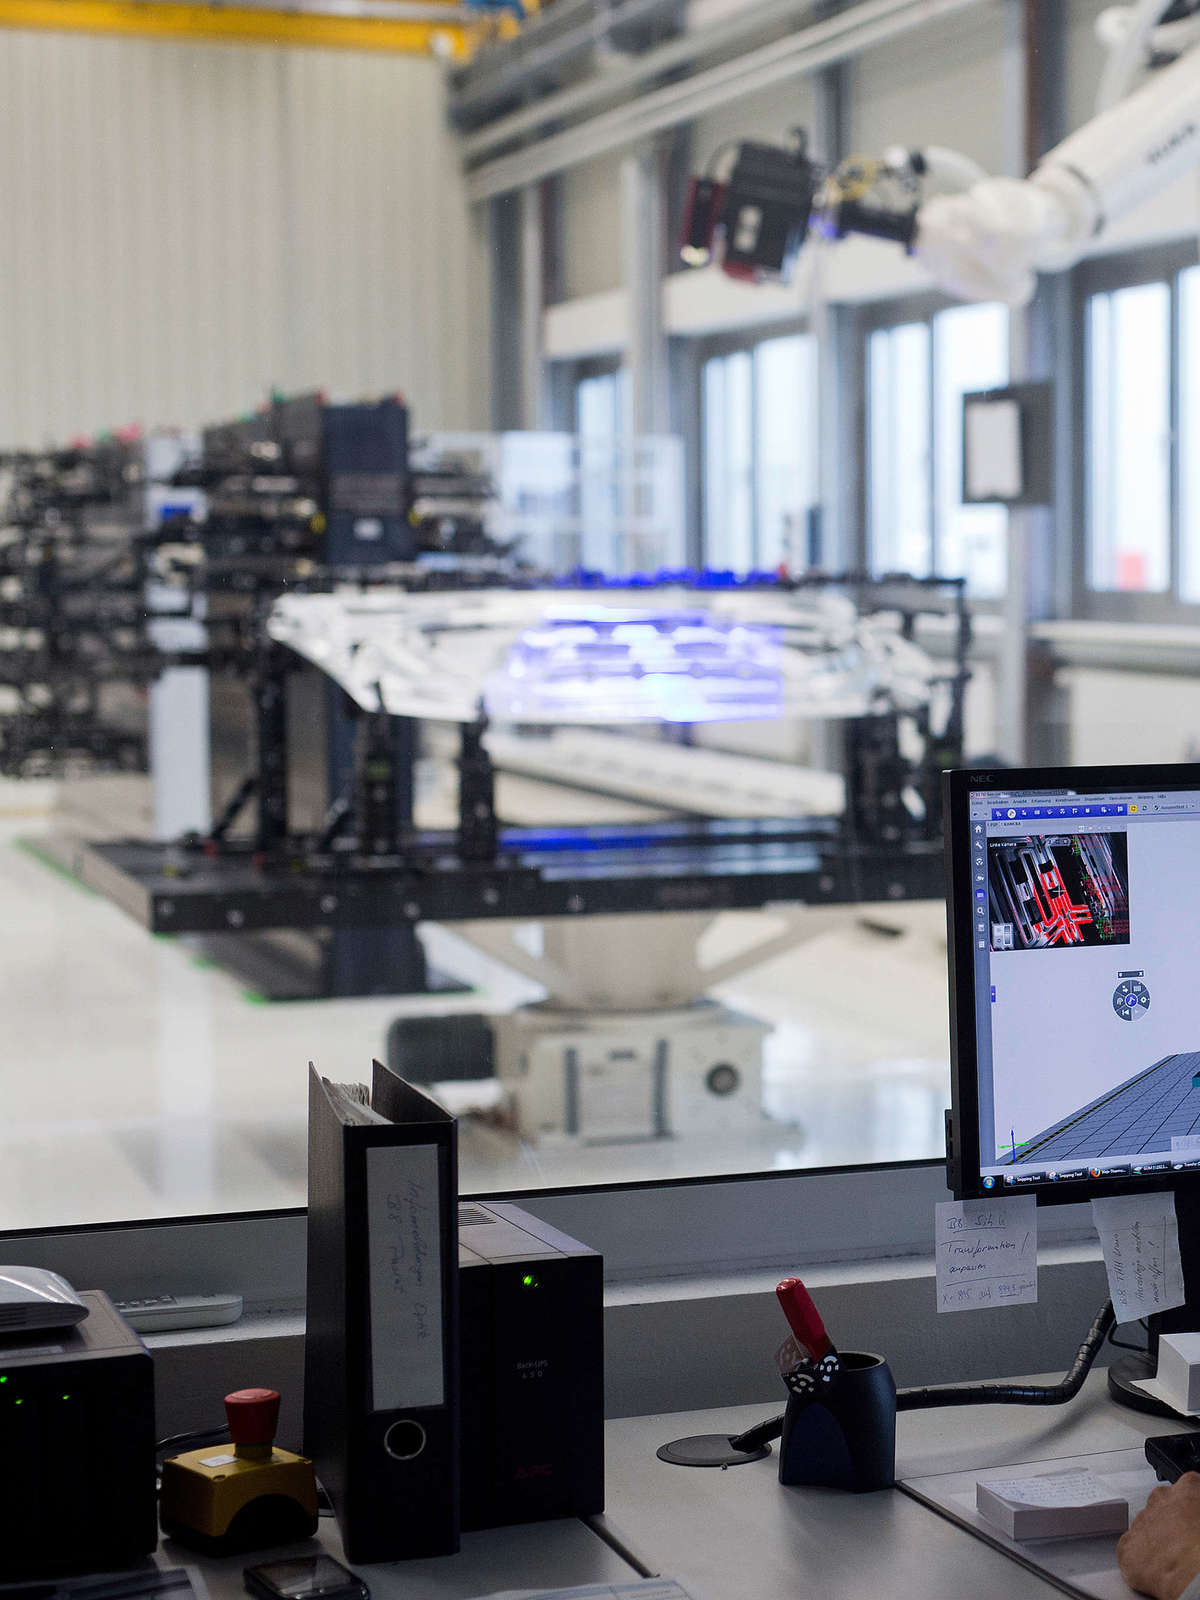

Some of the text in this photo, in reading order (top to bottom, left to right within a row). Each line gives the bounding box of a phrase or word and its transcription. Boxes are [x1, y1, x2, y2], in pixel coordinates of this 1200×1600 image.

[970, 775, 994, 783] NEC
[516, 1359, 549, 1369] Back-UPS
[514, 1464, 553, 1480] APC
